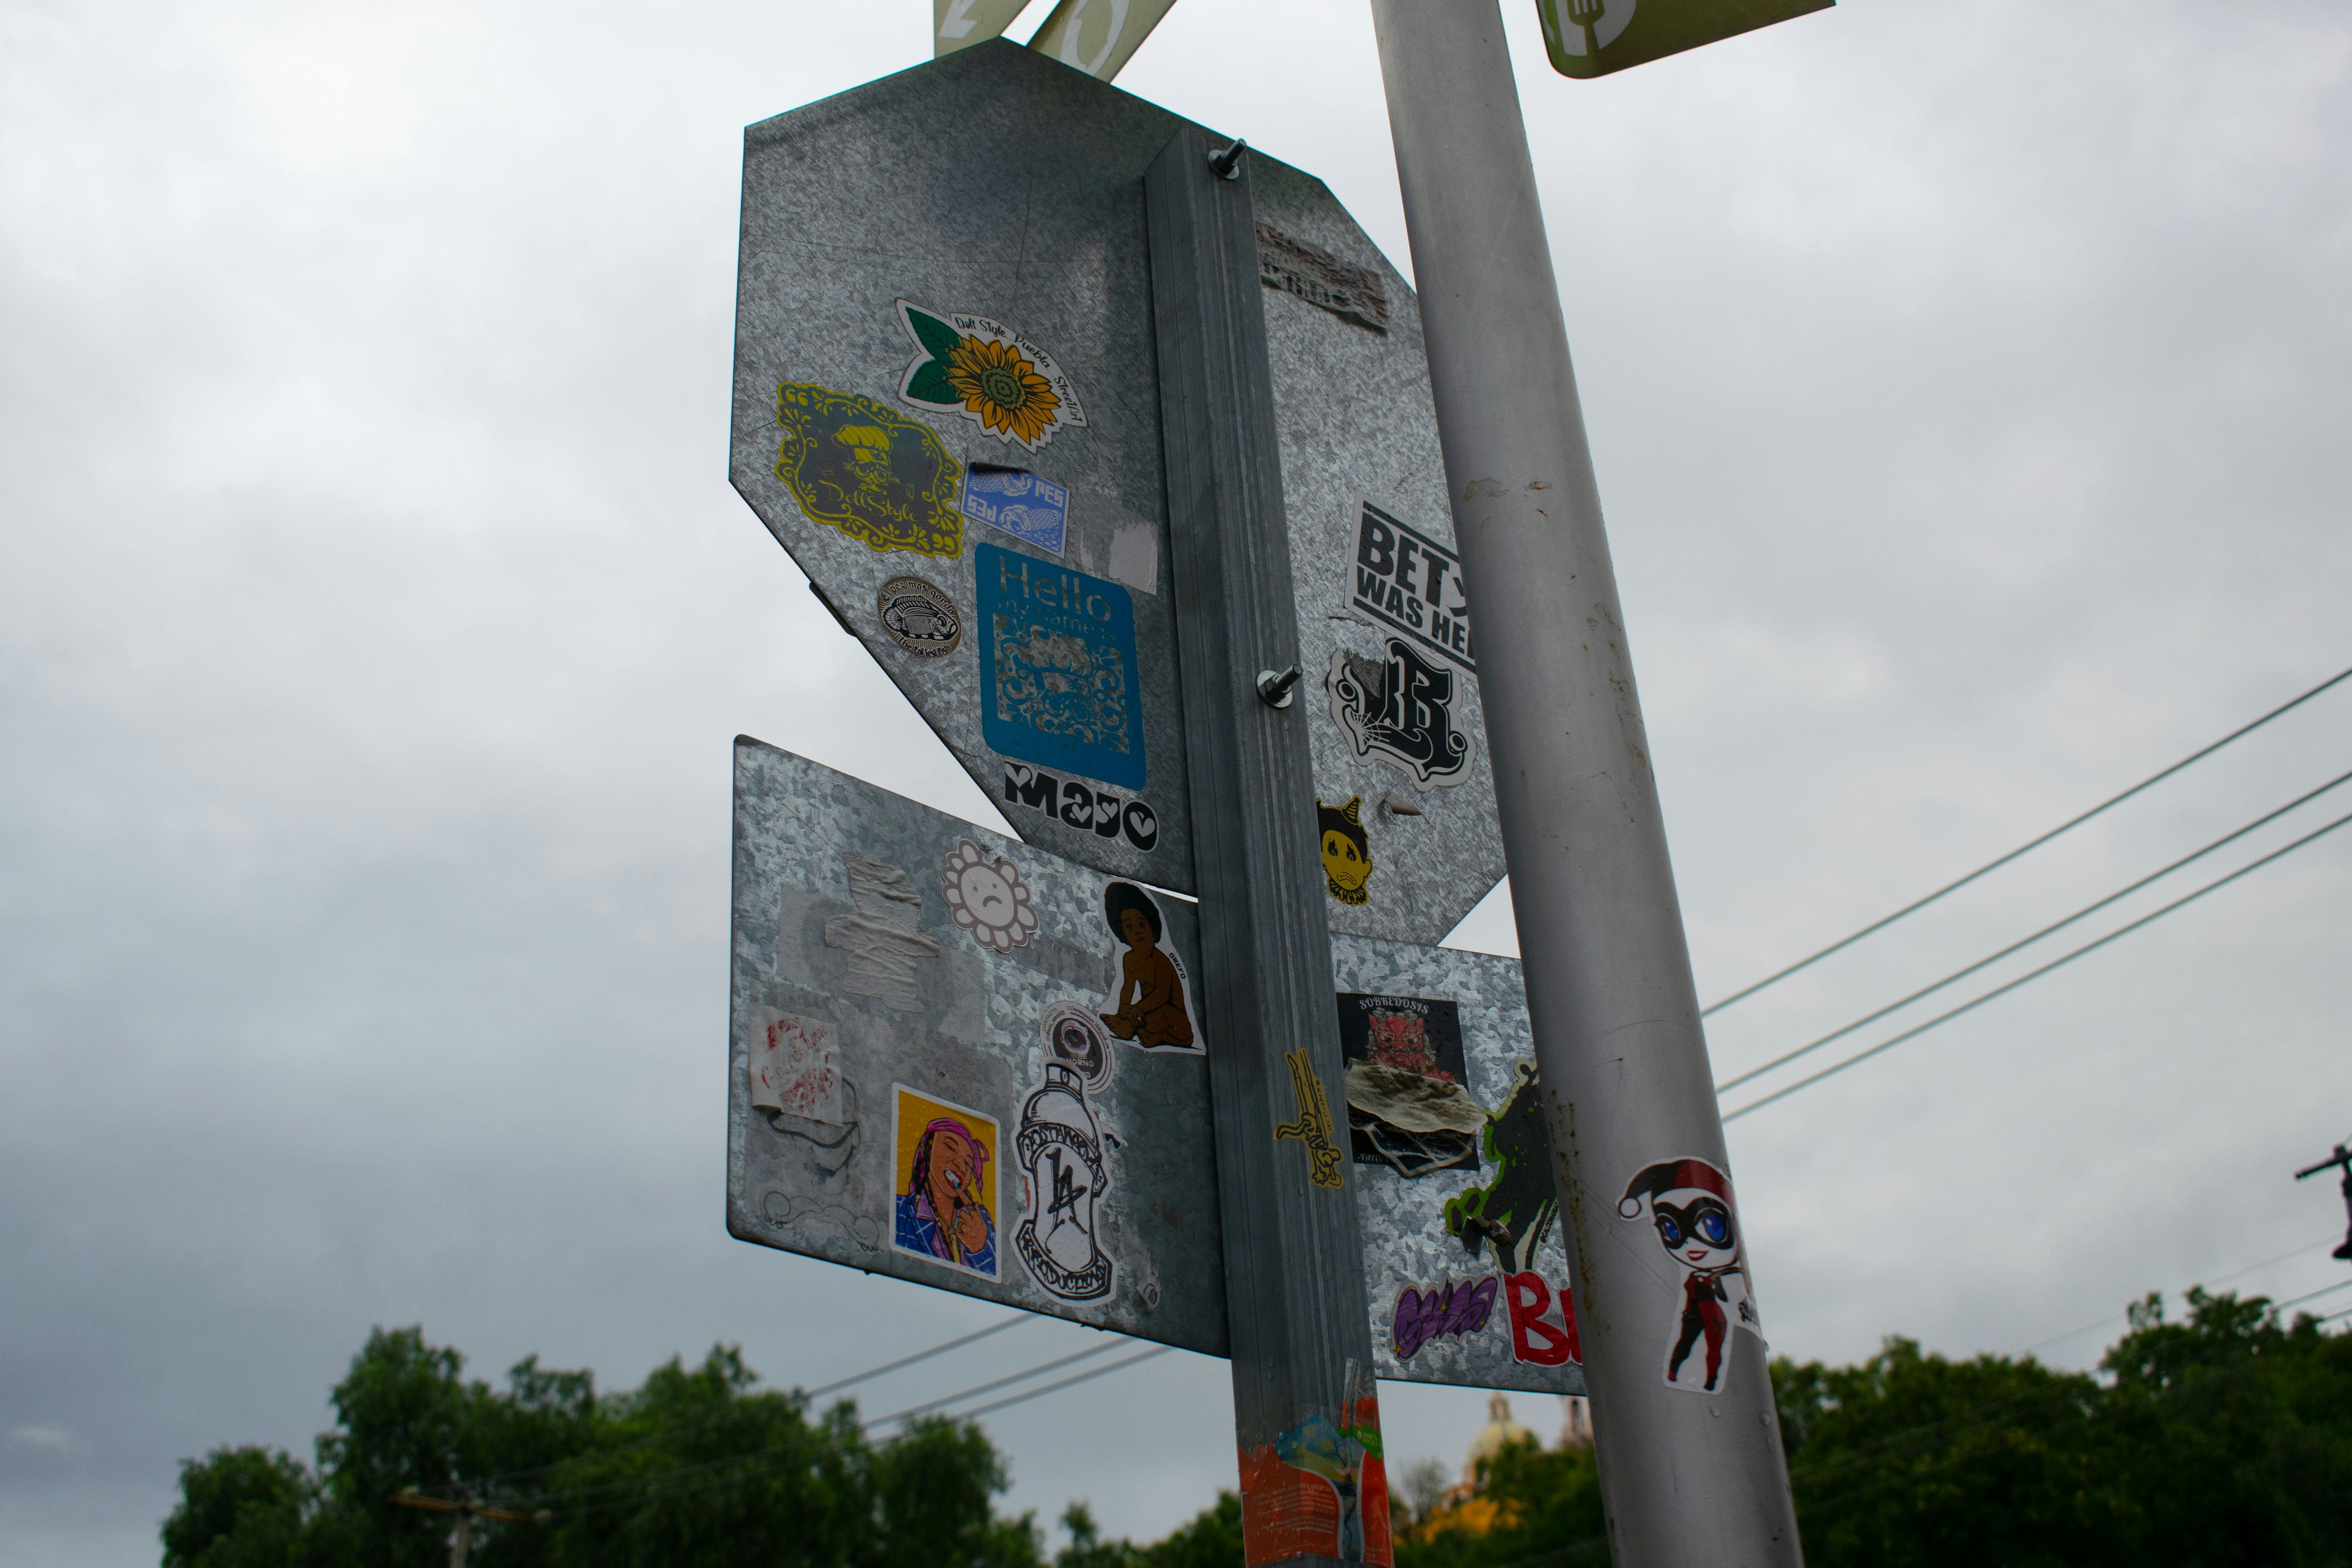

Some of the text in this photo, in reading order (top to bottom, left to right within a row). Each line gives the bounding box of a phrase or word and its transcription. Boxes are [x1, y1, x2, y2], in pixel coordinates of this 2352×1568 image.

[955, 316, 977, 330] Doll
[1035, 480, 1064, 508] PES
[907, 581, 928, 592] mas
[930, 590, 955, 615] gordo
[999, 555, 1111, 621] Hello
[998, 596, 1116, 641] my name is
[1357, 564, 1475, 660] WAS HE
[898, 637, 912, 650] The
[1359, 996, 1429, 1014] SOBREDOSIS
